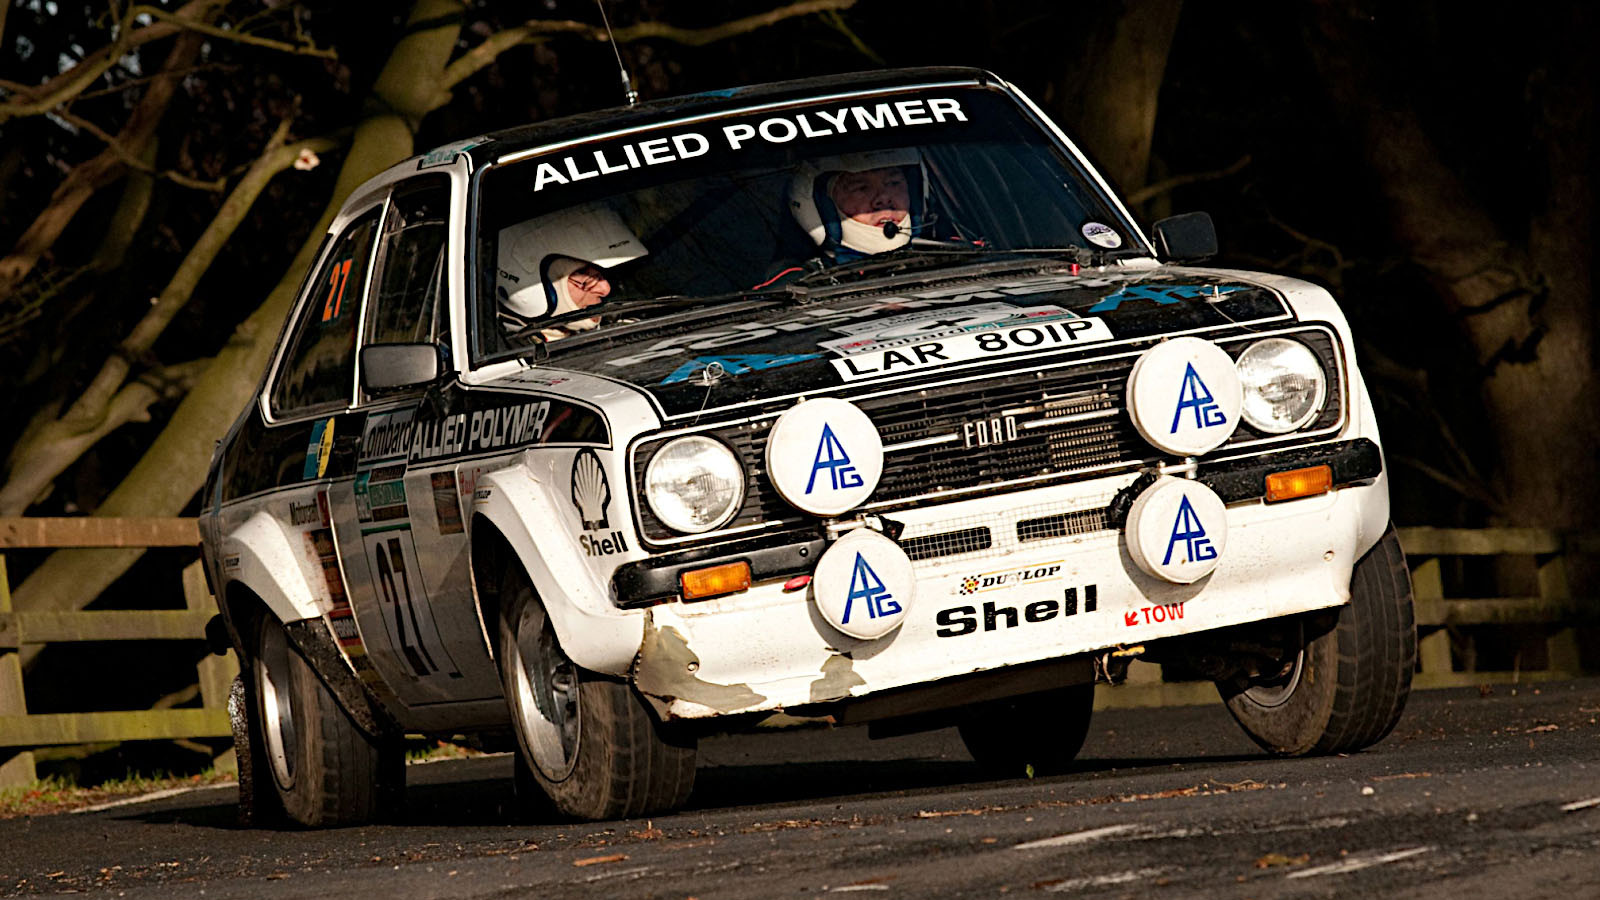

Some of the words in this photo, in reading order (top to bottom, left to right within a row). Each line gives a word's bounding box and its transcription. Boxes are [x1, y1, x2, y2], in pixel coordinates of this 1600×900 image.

[533, 131, 710, 192] ALLIED
[722, 97, 968, 151] POLYMER
[321, 258, 353, 322] 27
[843, 341, 951, 376] LAR
[409, 413, 466, 460] ALLIED
[469, 401, 550, 450] POLYMER
[964, 416, 1017, 448] FORD
[579, 531, 629, 557] Shell
[982, 565, 1061, 587] DULOP
[936, 584, 1097, 638] Shell
[1141, 601, 1185, 624] TOW
